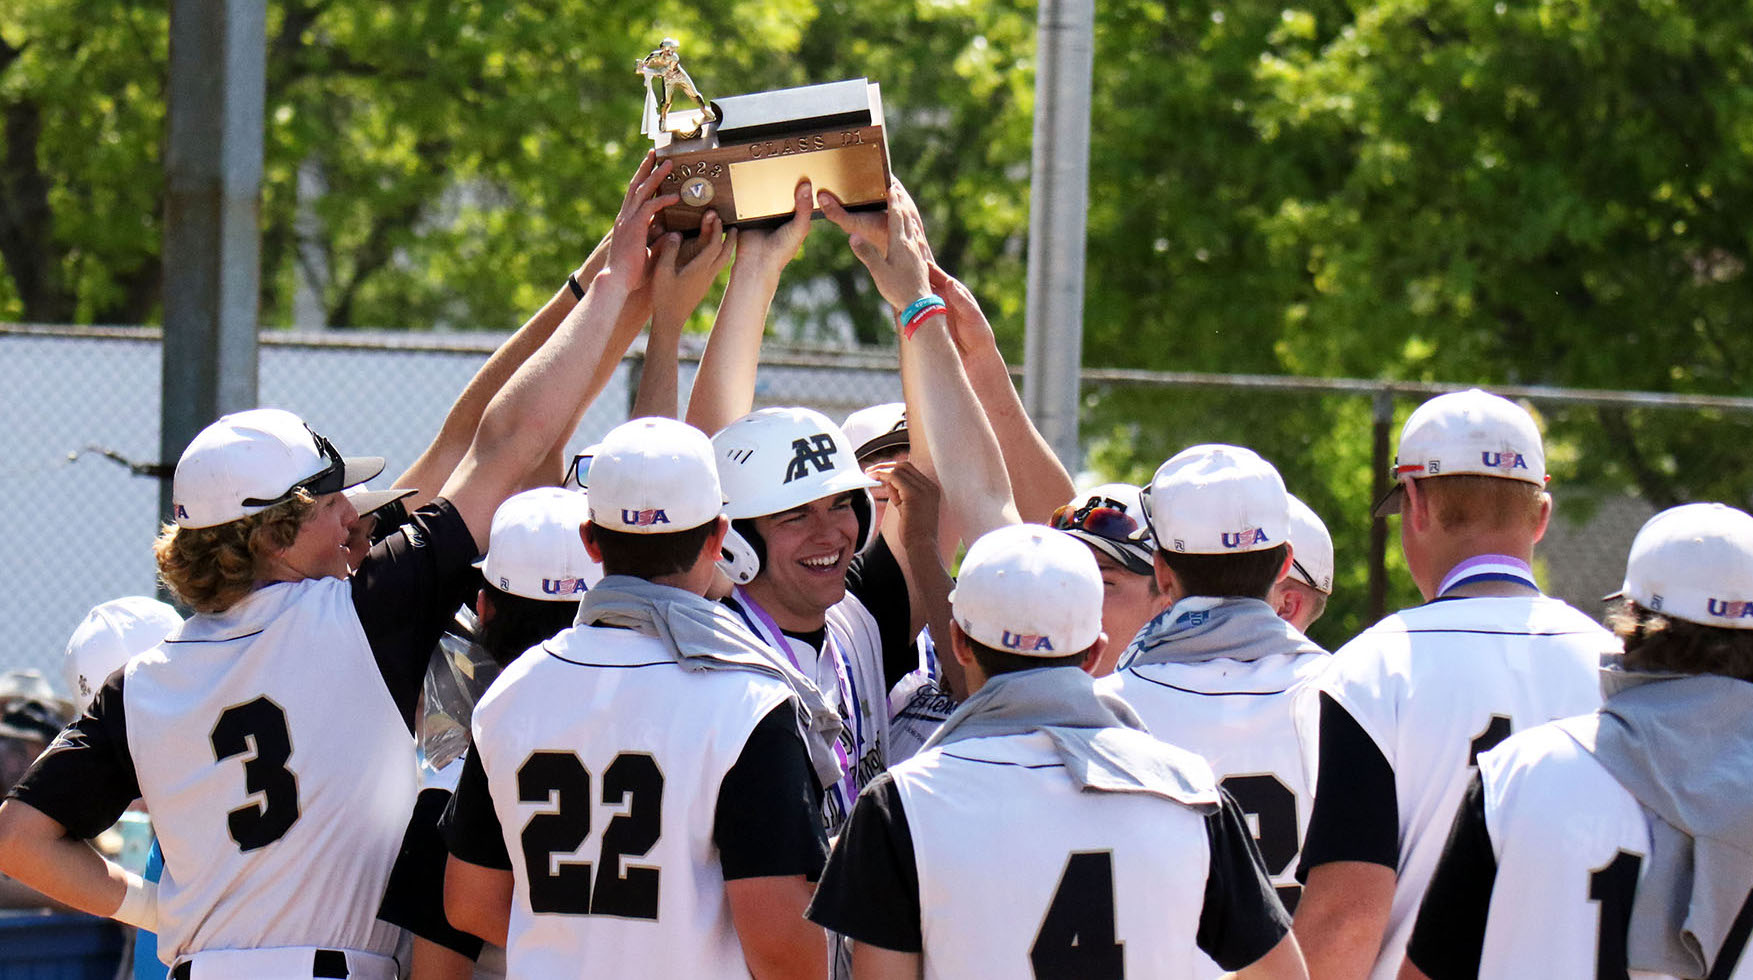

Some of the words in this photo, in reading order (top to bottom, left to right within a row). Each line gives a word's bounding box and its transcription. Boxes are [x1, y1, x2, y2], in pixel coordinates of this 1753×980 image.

[749, 134, 824, 158] CLASS
[667, 161, 723, 183] 2023
[783, 433, 837, 485] AP
[1481, 450, 1528, 469] USA
[620, 509, 671, 526] USA
[1221, 528, 1269, 549] USA
[542, 577, 589, 595] USA
[1001, 629, 1054, 650] USA
[208, 694, 301, 855] 3
[515, 749, 665, 923] 22
[1027, 848, 1127, 980] 4
